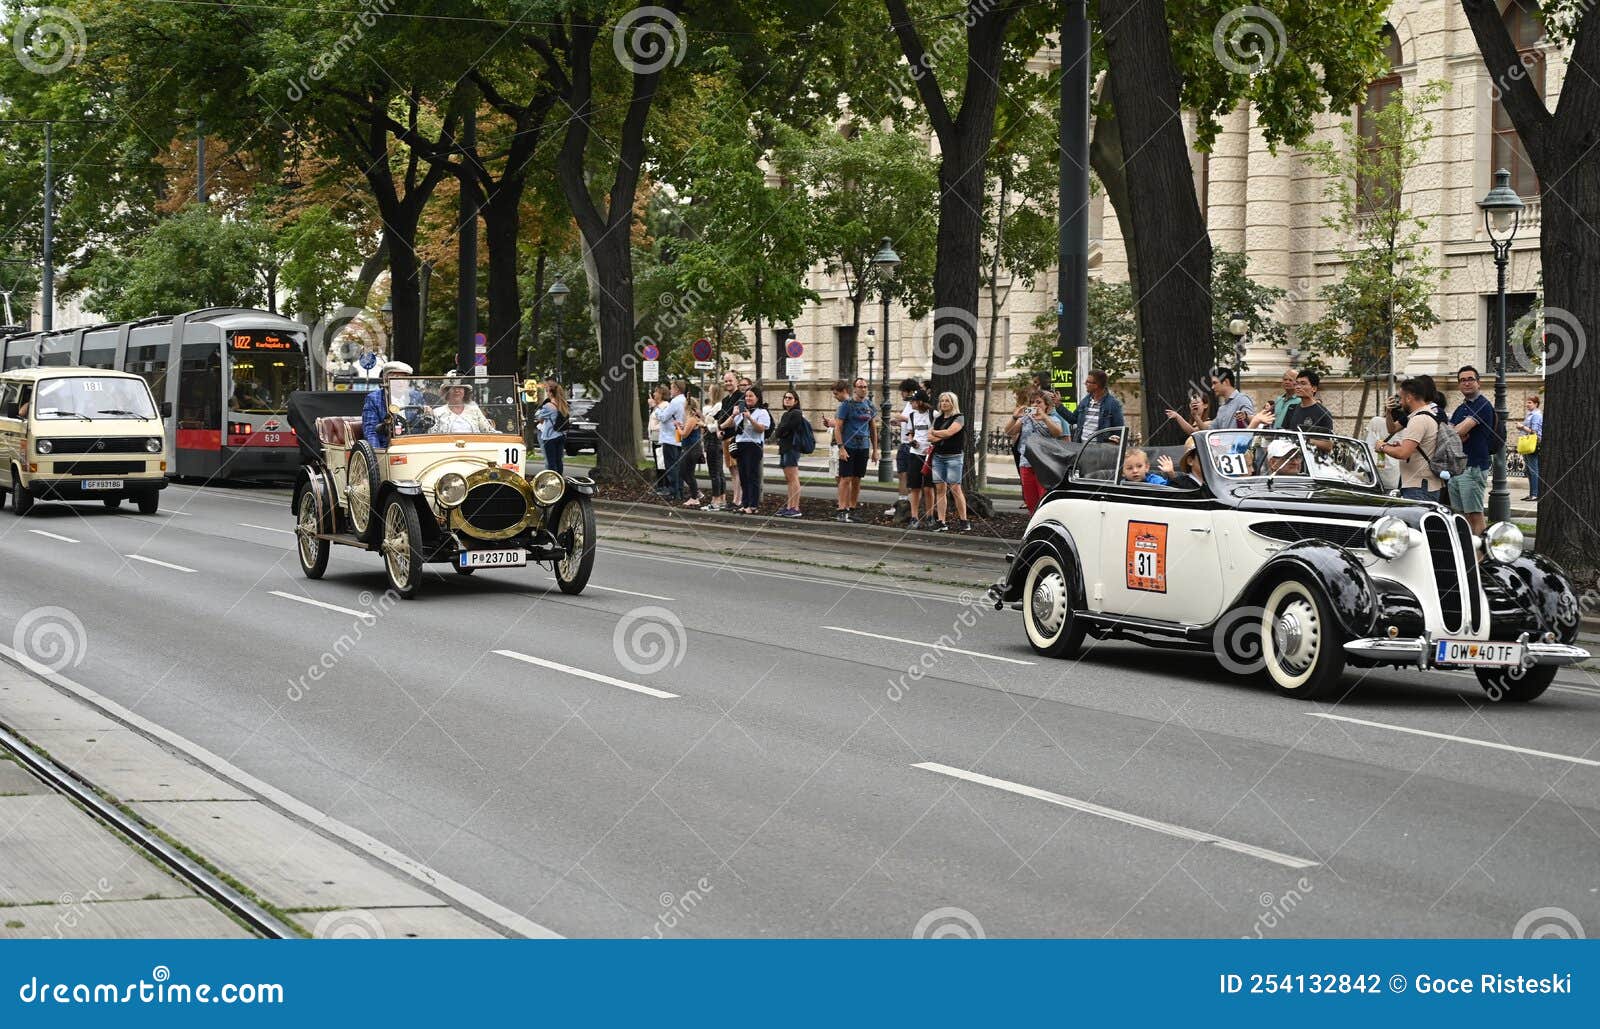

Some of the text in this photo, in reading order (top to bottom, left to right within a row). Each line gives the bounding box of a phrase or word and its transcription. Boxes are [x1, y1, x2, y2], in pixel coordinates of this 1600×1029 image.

[264, 433, 280, 443] 629
[504, 448, 519, 464] 10
[1220, 454, 1246, 474] 31
[472, 553, 479, 564] P
[1138, 553, 1152, 577] 31
[1498, 646, 1513, 661] TF
